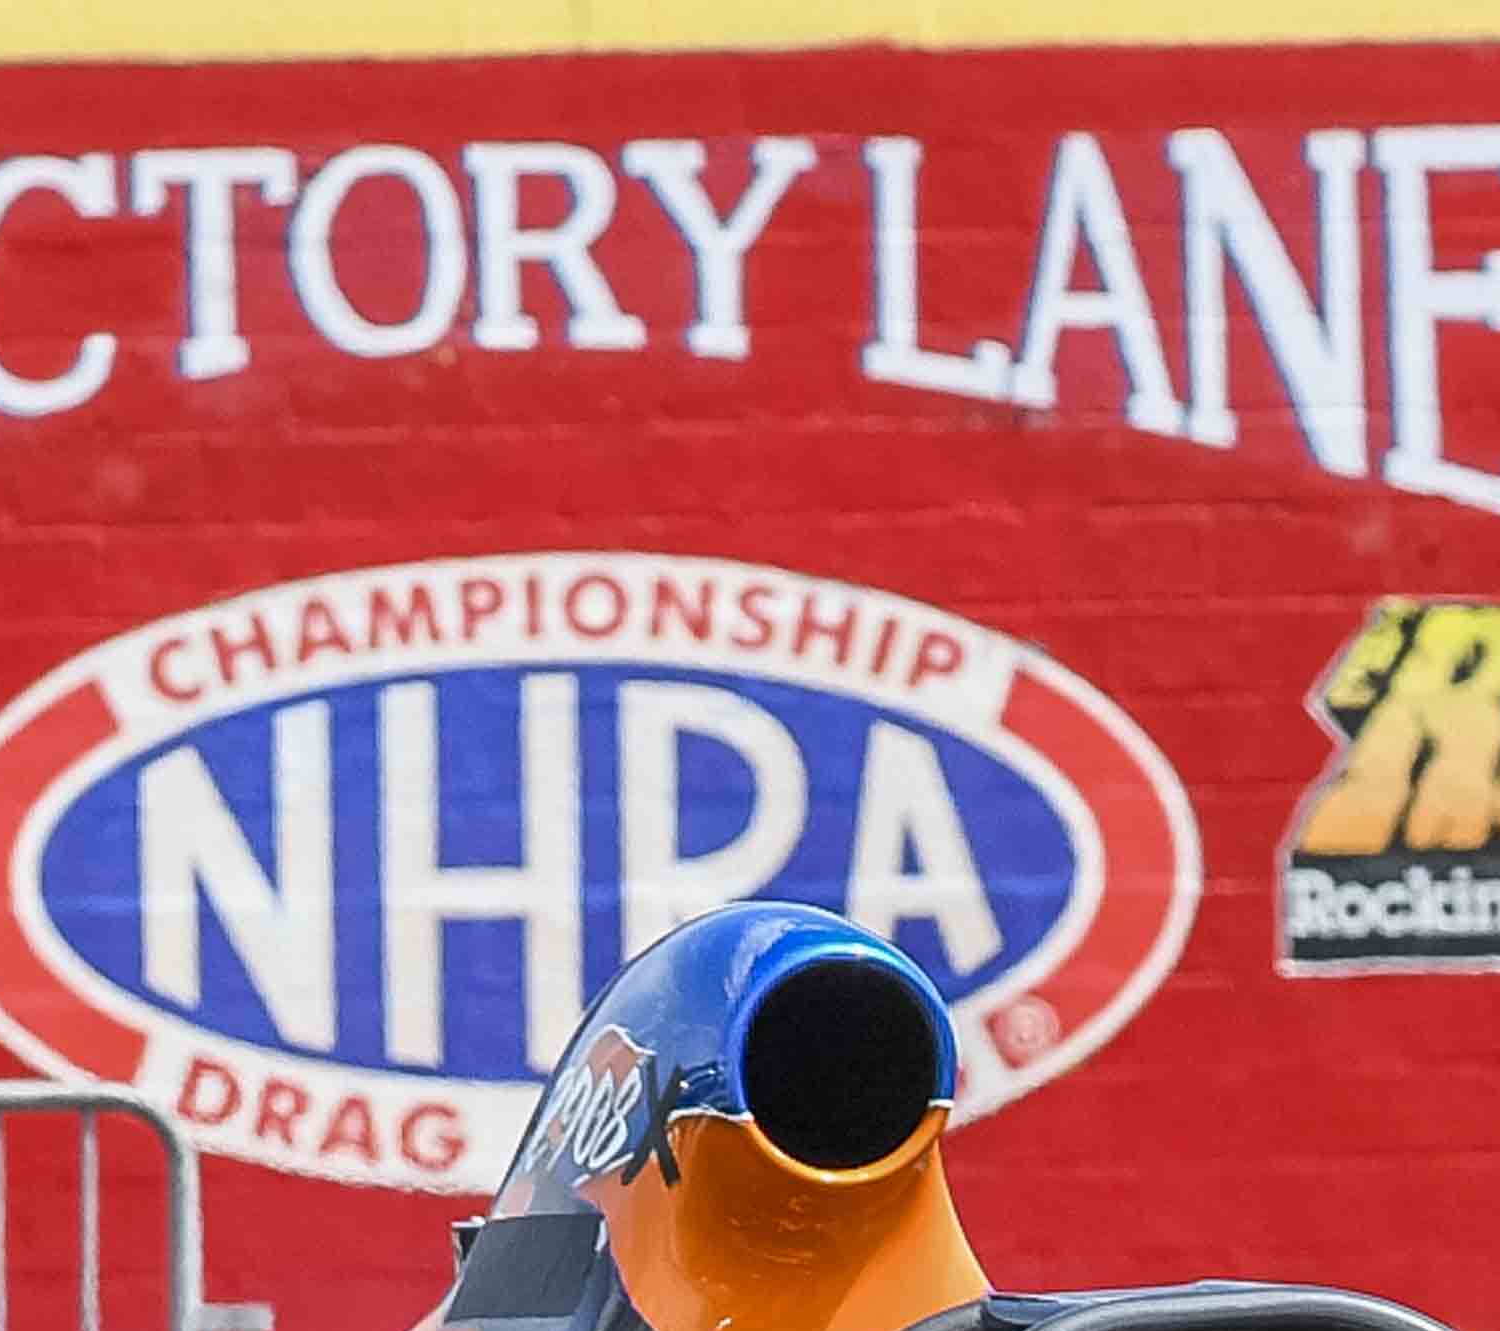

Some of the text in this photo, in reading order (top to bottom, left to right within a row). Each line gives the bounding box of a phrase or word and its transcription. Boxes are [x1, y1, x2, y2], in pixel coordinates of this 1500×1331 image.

[148, 570, 966, 704] CHAMPIONSHIP
[138, 664, 1007, 1074] NHRA
[176, 1054, 470, 1172] DRAG
